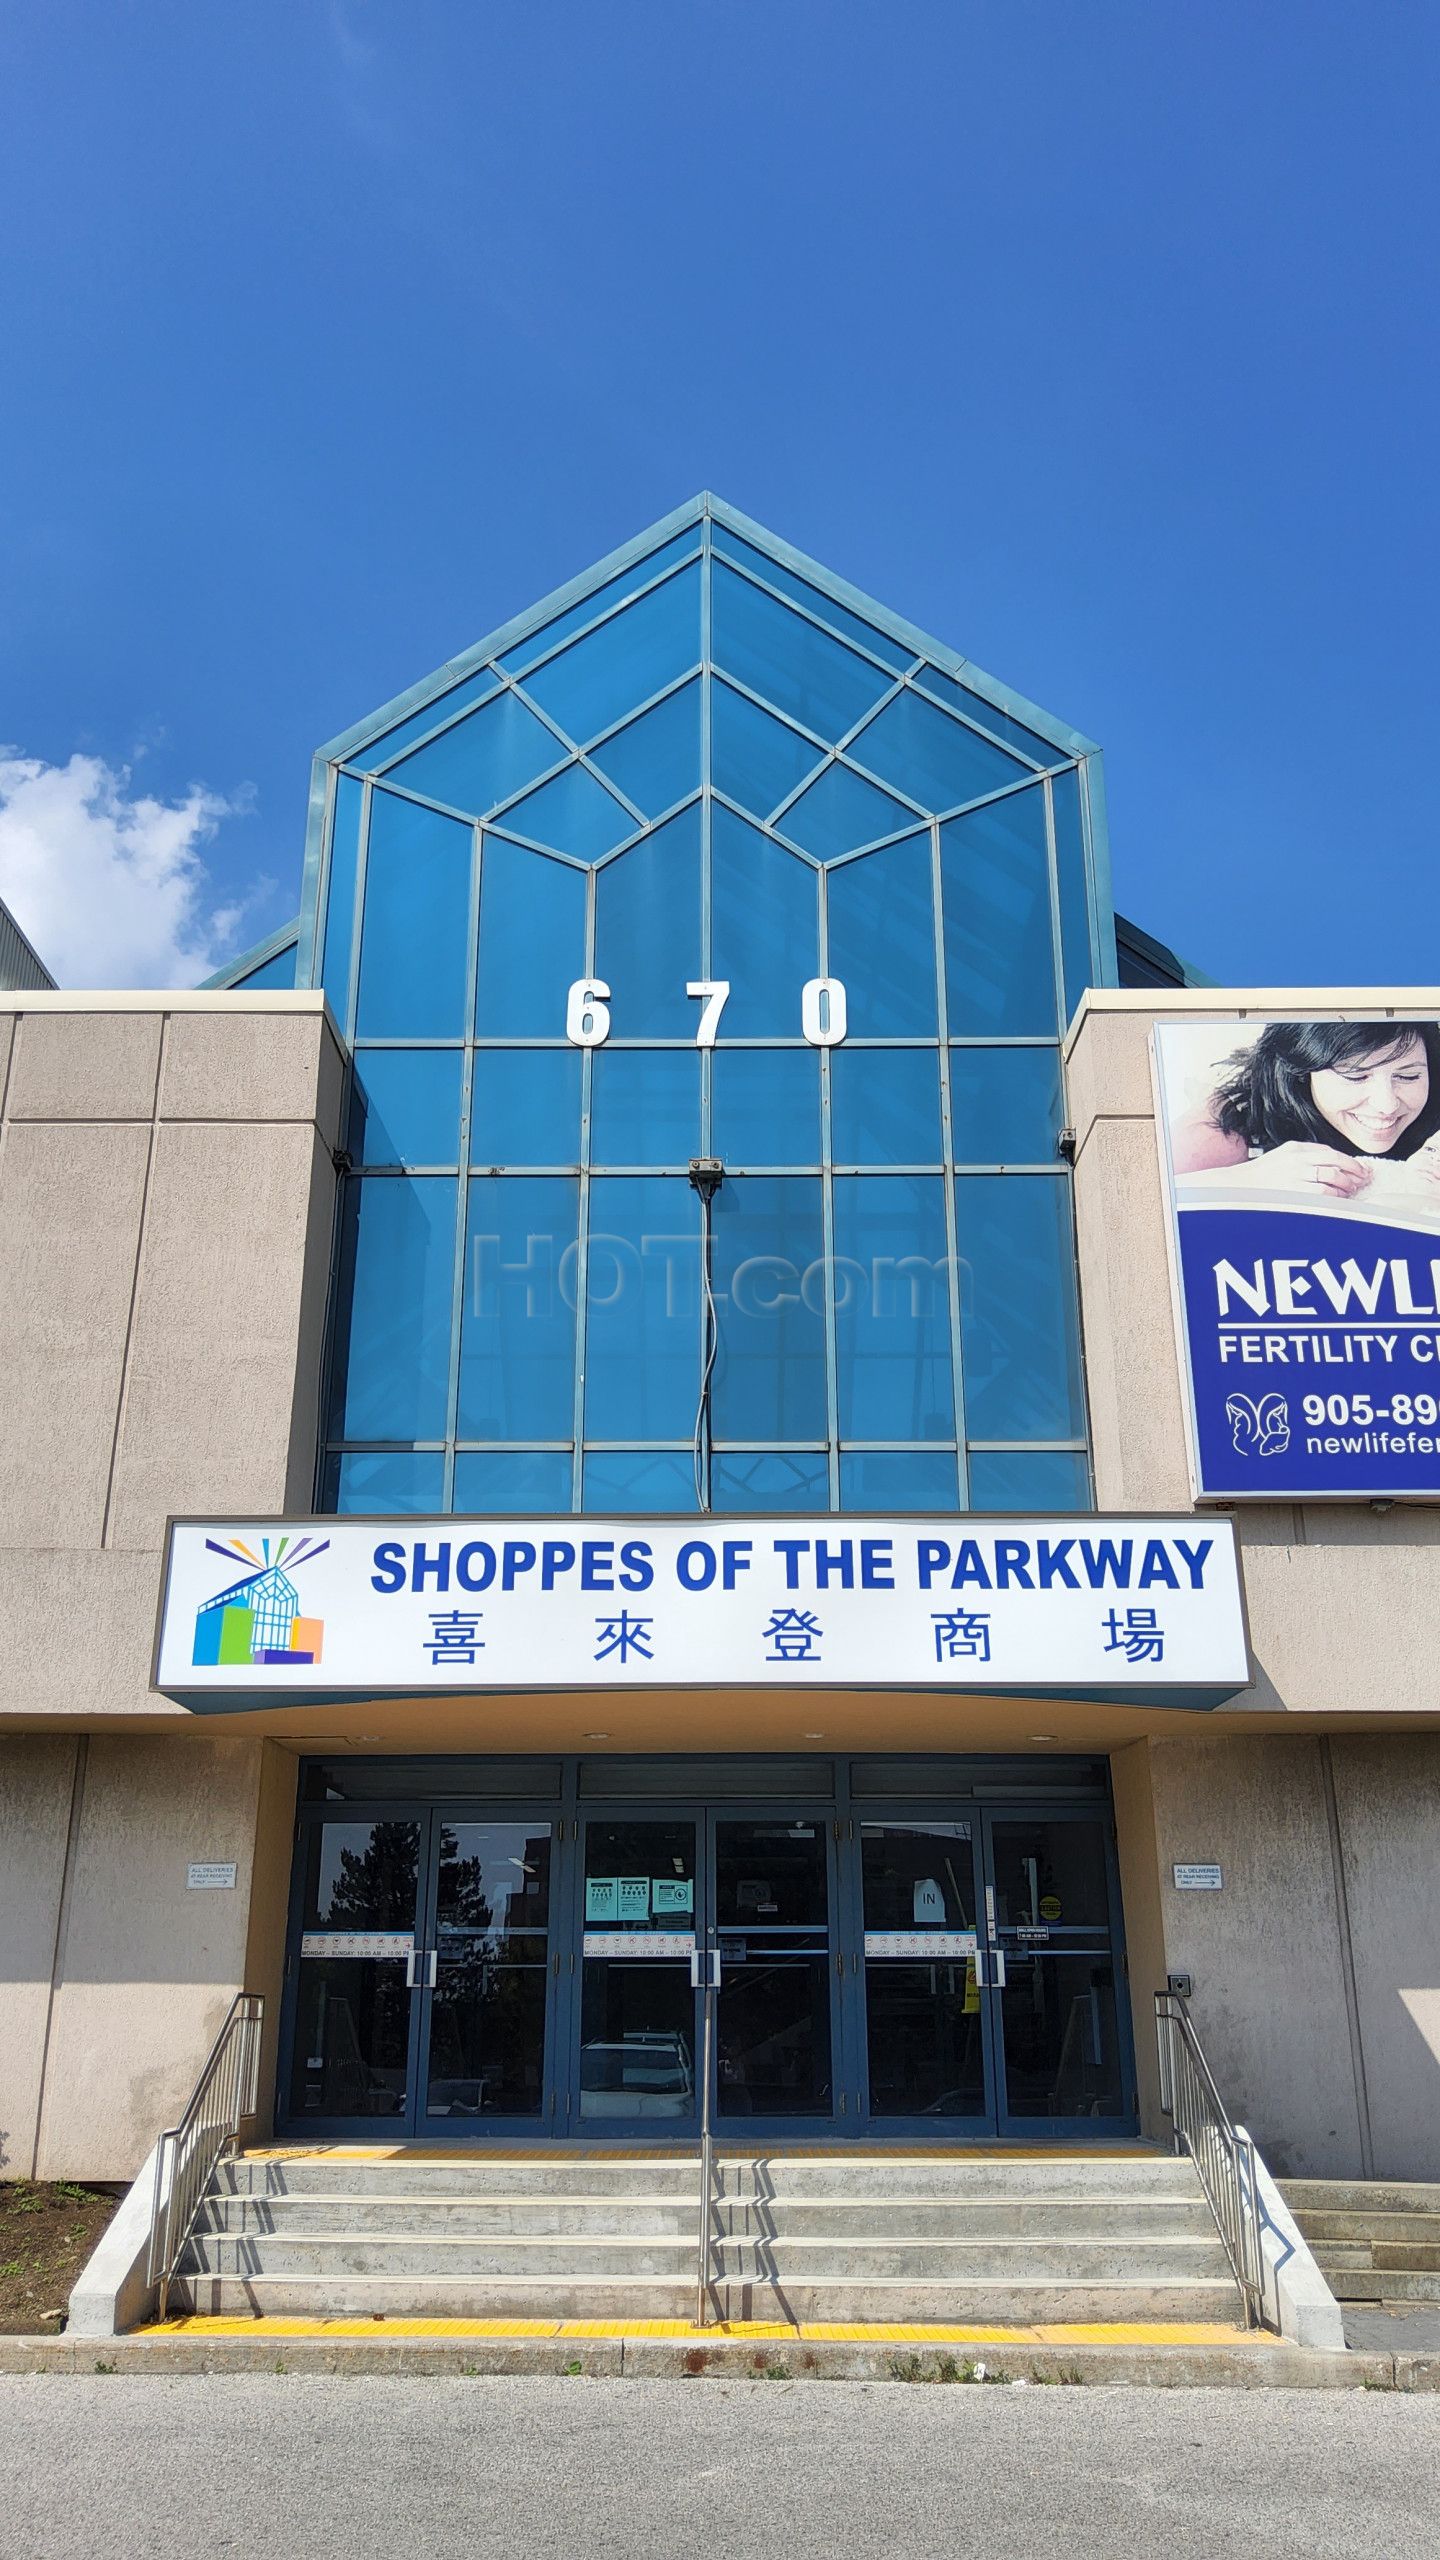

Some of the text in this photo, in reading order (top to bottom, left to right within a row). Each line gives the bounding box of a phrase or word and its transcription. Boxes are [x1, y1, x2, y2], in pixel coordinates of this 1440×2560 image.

[1218, 1335, 1440, 1363] FERTILITY C
[1302, 1394, 1440, 1426] 905-89
[370, 1539, 1214, 1594] SHOPPES OF THE PARKWAY
[422, 1607, 1165, 1665] 喜來登商場
[923, 1892, 936, 1905] IN
